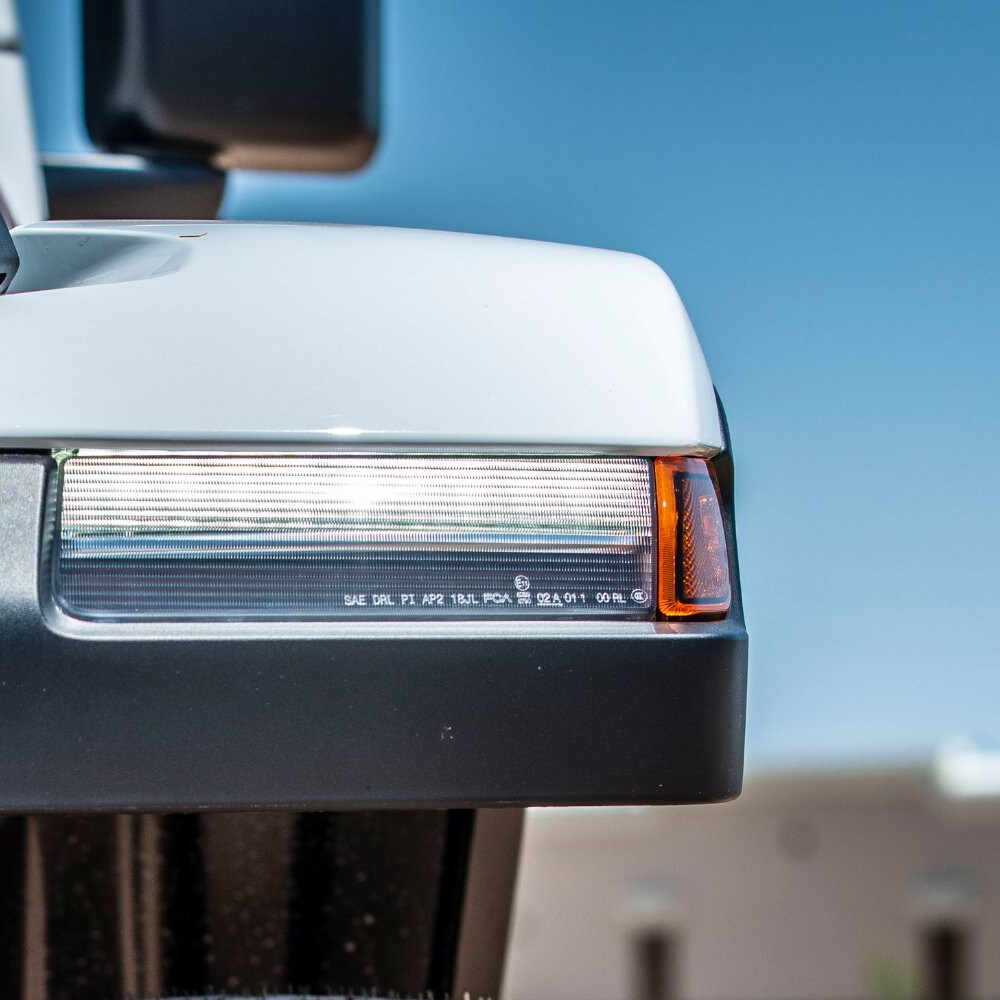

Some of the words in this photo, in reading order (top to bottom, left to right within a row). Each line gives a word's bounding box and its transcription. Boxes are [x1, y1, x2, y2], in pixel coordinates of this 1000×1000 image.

[344, 594, 366, 606] SAE
[373, 594, 394, 605] DRL
[422, 594, 444, 605] AP2
